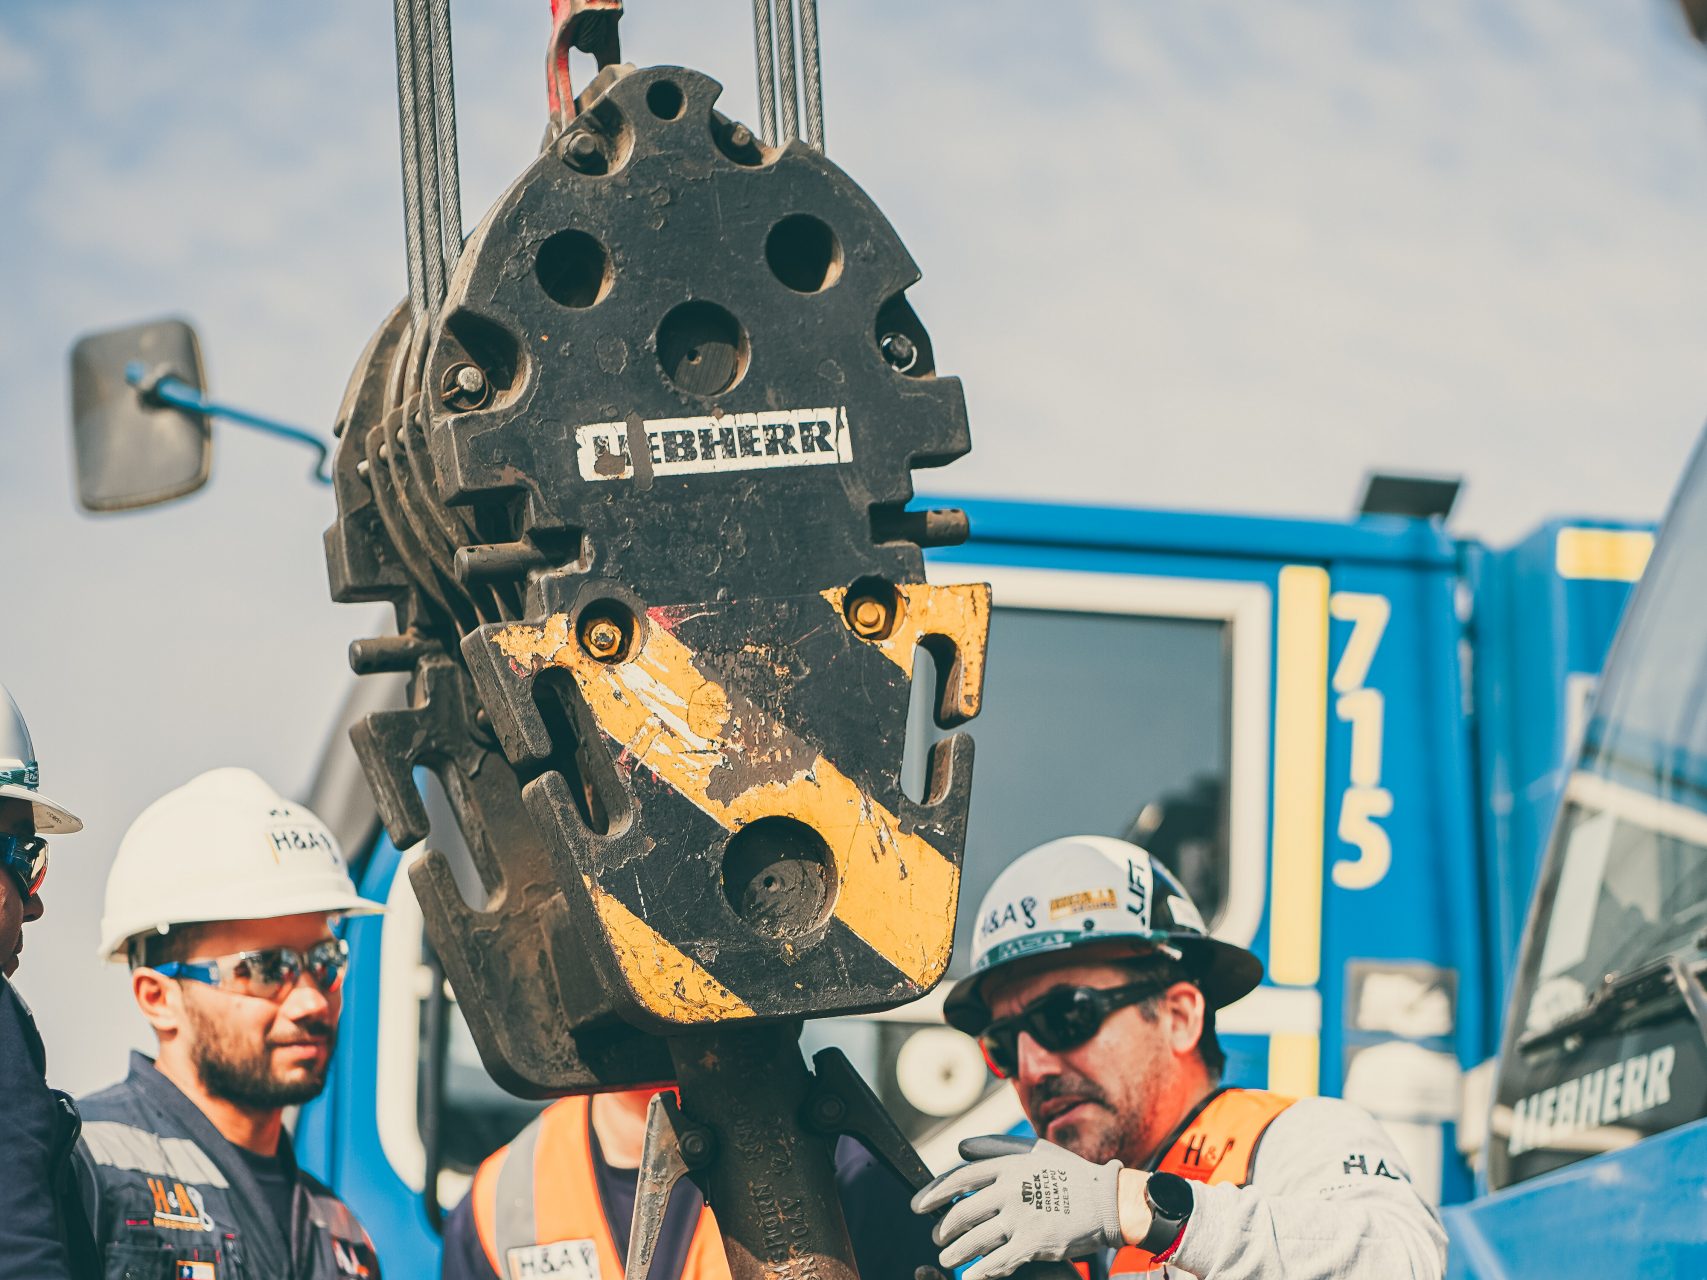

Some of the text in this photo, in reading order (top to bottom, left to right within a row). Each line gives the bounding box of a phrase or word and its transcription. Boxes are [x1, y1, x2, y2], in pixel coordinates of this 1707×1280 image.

[1329, 590, 1394, 892] 715
[1507, 1044, 1676, 1158] LIEBHERR
[1033, 1173, 1043, 1210] ROCK
[1042, 1168, 1052, 1213] GRIS FLEX
[1052, 1182, 1061, 1212] PALMA
